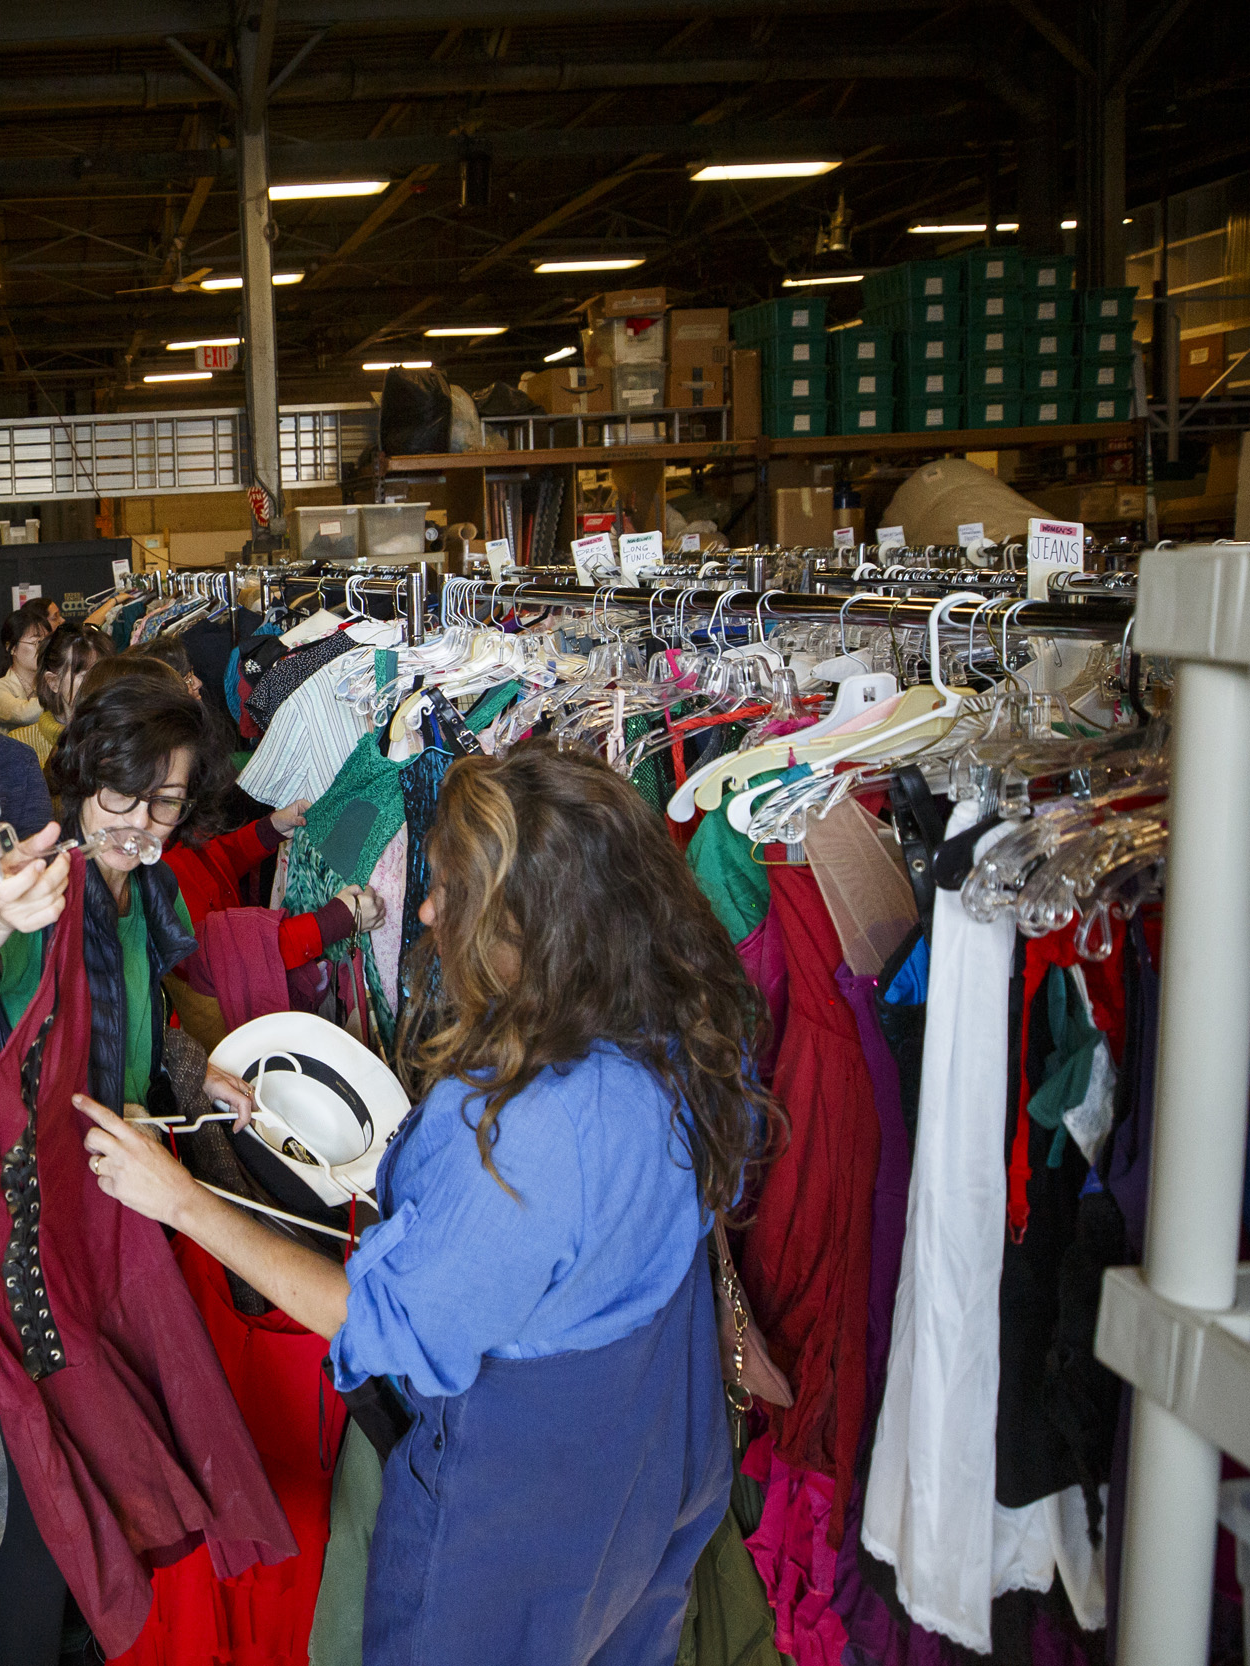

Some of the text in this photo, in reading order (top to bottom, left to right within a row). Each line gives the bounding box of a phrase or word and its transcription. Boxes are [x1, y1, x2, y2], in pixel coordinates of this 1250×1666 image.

[203, 346, 229, 368] EXIT
[1042, 525, 1073, 535] WOMEN'S
[576, 545, 608, 557] DRESS
[622, 544, 649, 554] LONG
[1032, 536, 1080, 565] JEANS
[624, 553, 658, 564] TUNICS
